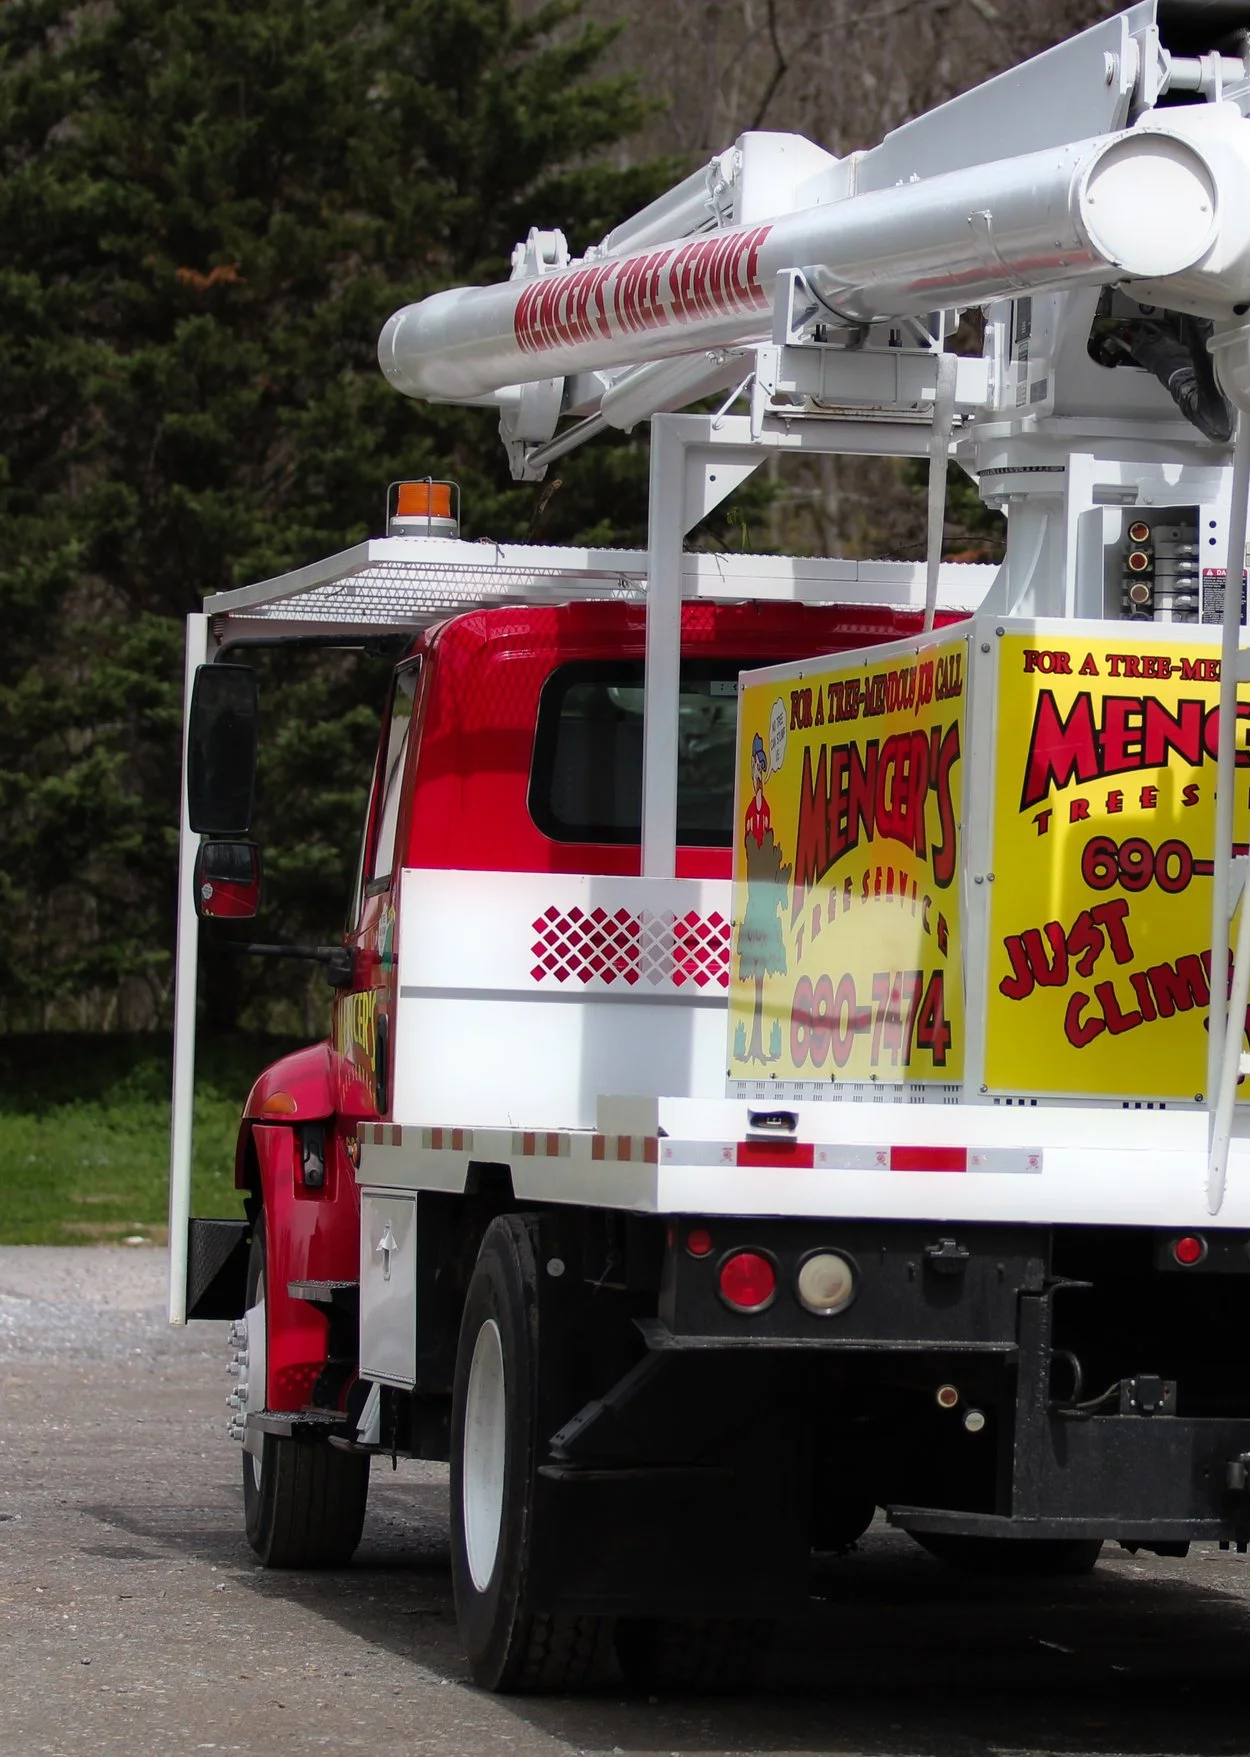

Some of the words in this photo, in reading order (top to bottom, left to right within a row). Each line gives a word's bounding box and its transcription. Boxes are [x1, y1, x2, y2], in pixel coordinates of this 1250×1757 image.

[513, 261, 620, 355] MENCER'S
[613, 248, 676, 335] TREE
[669, 224, 775, 326] SERVICE
[789, 688, 813, 731] FOR
[814, 684, 825, 727] A
[914, 660, 935, 717] JOB
[935, 652, 964, 702] CALL
[1022, 649, 1073, 676] FOR
[1078, 652, 1099, 677] A
[789, 718, 961, 932] MENCER'S
[1031, 785, 1160, 837] TREE
[794, 876, 853, 965] TREE
[861, 866, 950, 959] SERVICE
[999, 898, 1135, 1001] JUST
[789, 969, 952, 1069] 690-7474
